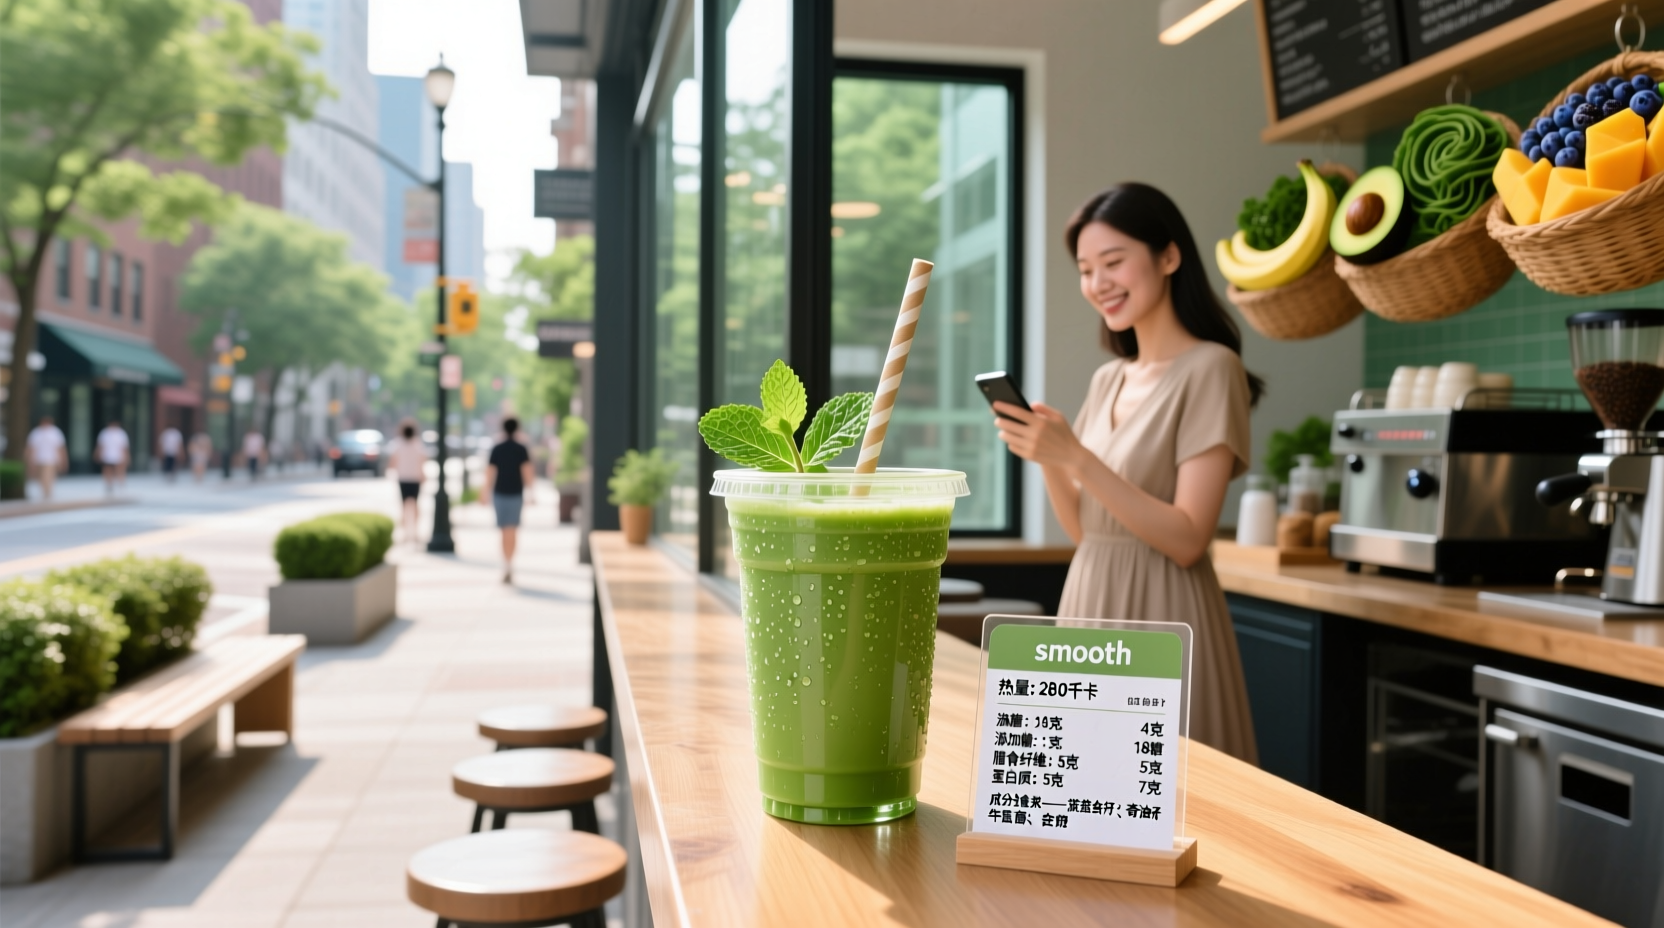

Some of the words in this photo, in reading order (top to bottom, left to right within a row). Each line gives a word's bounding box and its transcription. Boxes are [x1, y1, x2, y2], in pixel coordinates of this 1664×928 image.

[1034, 639, 1132, 665] smooth
[1140, 721, 1165, 738] 4克
[1139, 759, 1163, 776] 5克
[1138, 779, 1162, 796] 7克
